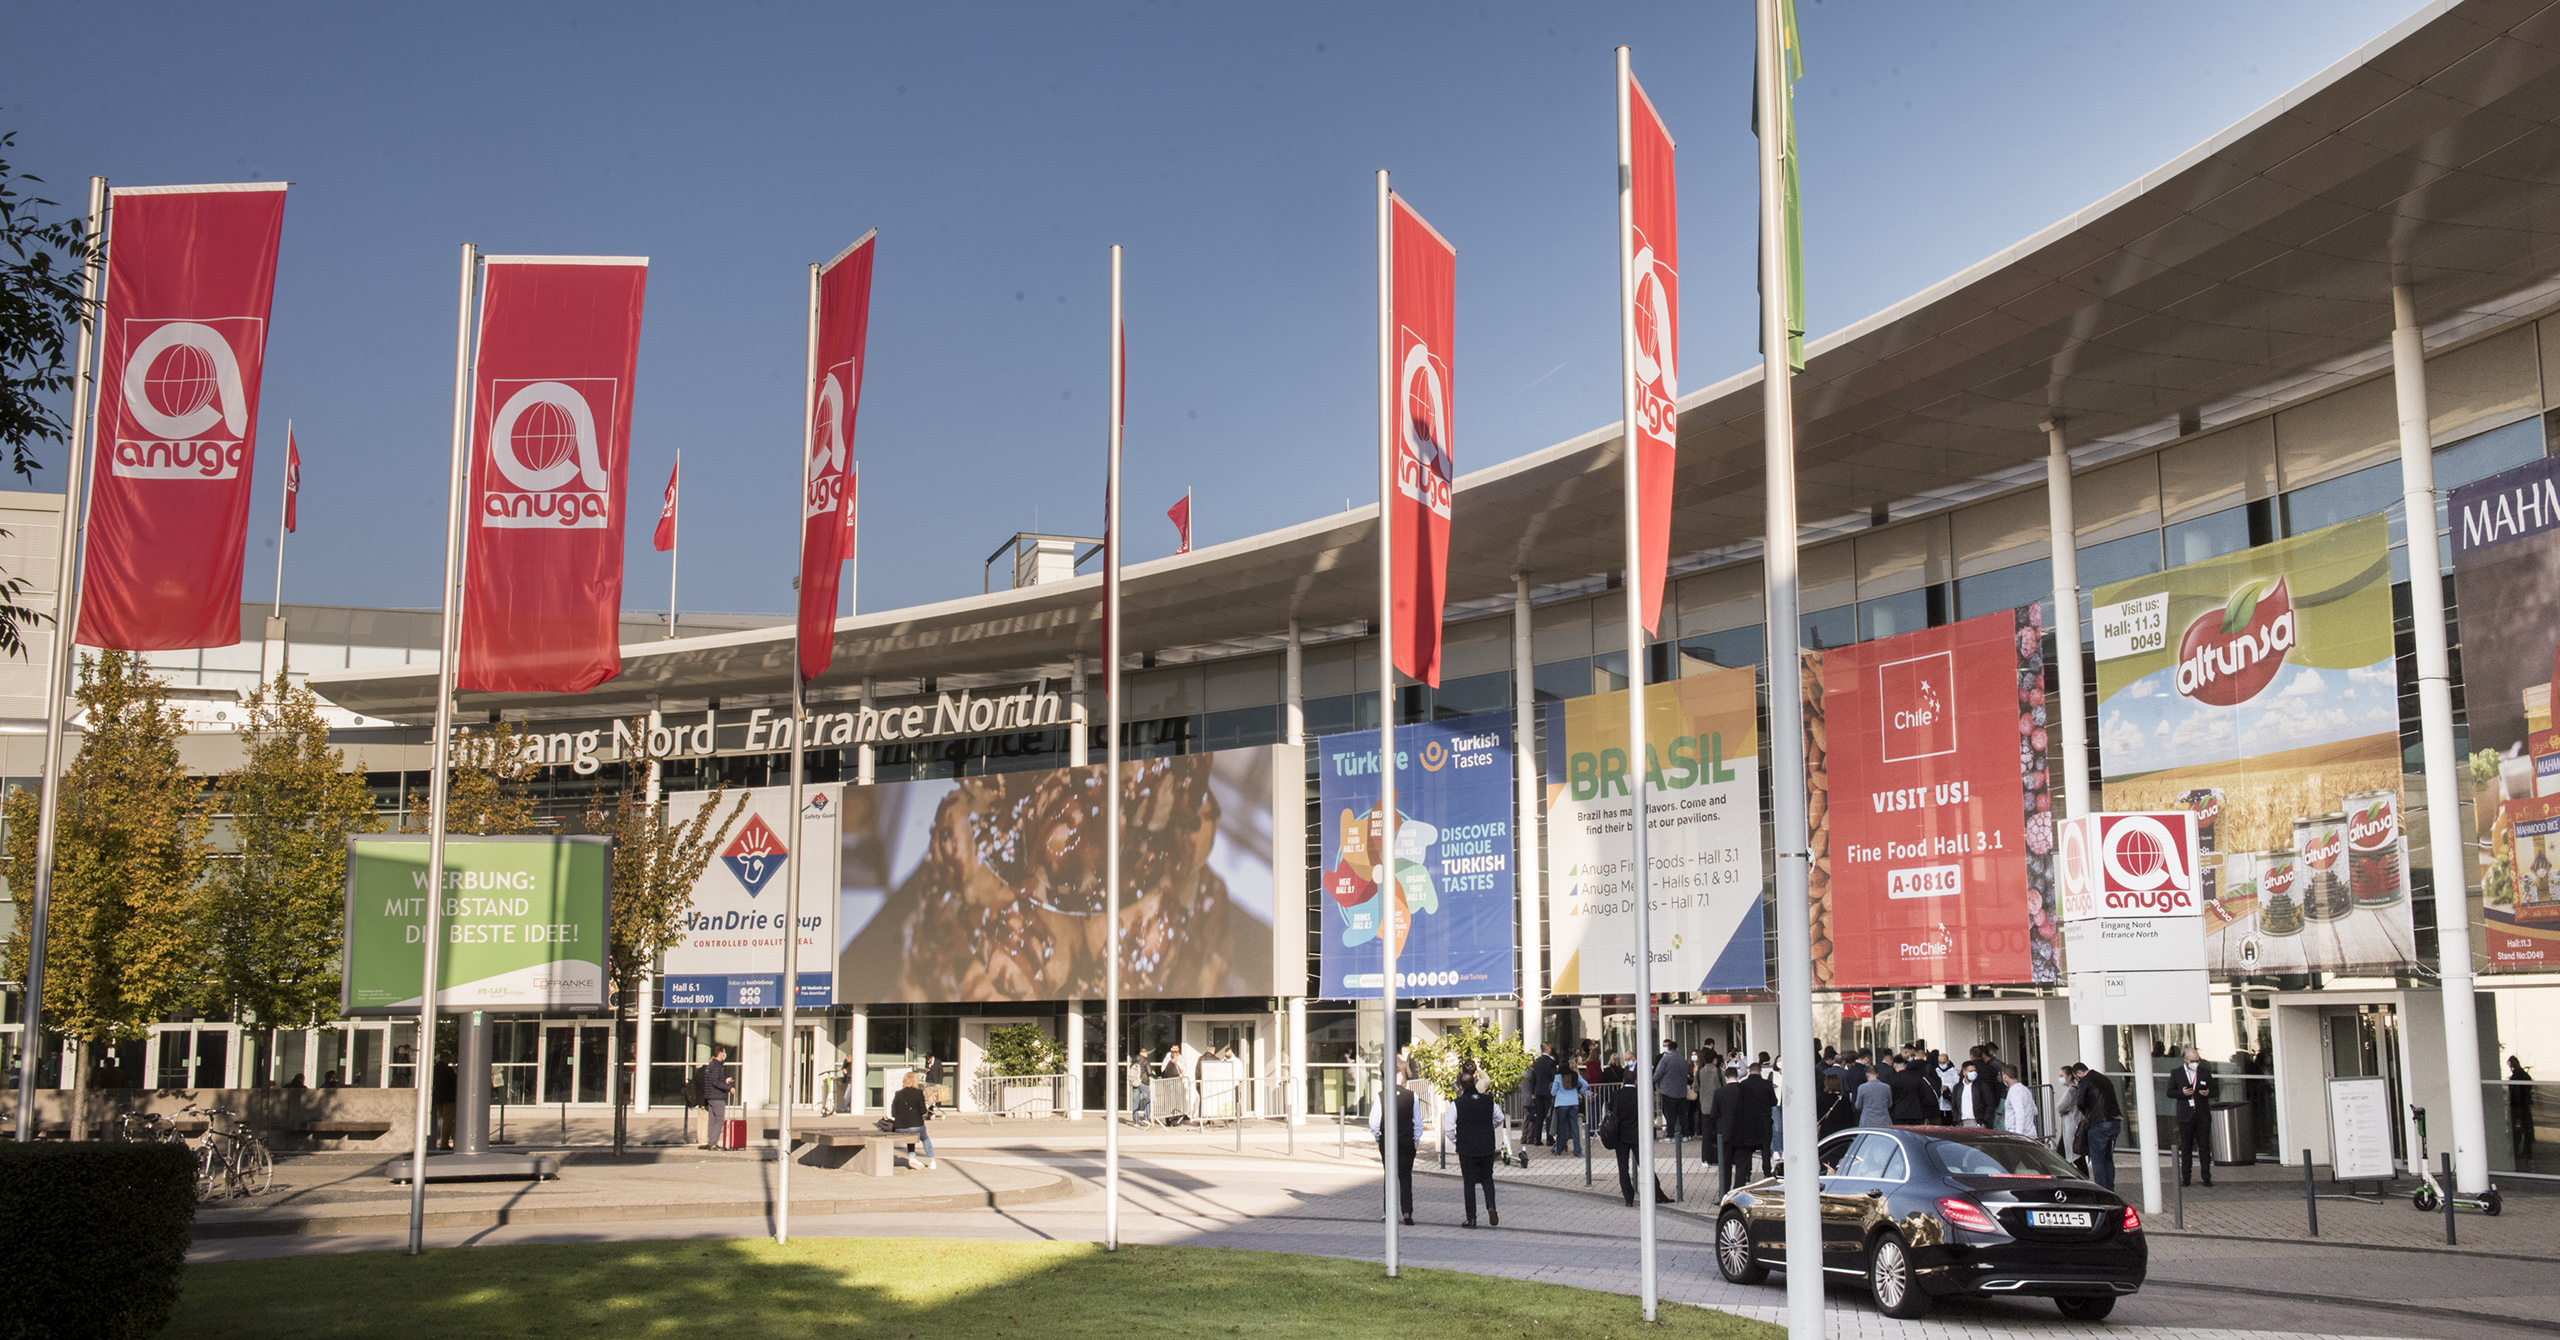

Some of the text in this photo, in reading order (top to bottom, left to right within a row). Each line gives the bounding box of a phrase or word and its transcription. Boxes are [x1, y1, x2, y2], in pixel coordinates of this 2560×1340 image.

[485, 493, 607, 526] anuga
[2121, 599, 2160, 617] Visit us:
[2104, 613, 2161, 639] Hall: 11.3
[2131, 632, 2162, 651] D049
[2177, 610, 2294, 696] altunsa
[612, 709, 715, 759] Nord
[745, 703, 928, 751] Entrance
[932, 676, 1064, 735] North
[1894, 706, 1932, 730] Chile
[1451, 732, 1500, 752] Turkish
[1333, 748, 1409, 777] Türkie
[1452, 753, 1493, 769] Tastes
[1571, 731, 1736, 802] BRASIL
[1872, 781, 1970, 813] VISIT US!
[1577, 810, 1601, 822] Brazil
[1603, 809, 1618, 819] has
[1680, 797, 1707, 810] Come
[1709, 794, 1727, 806] and
[1348, 827, 1359, 835] FINE
[1441, 821, 1506, 842] DISCOVER
[1586, 825, 1603, 835] find
[1604, 821, 1625, 833] their
[1648, 819, 1657, 829] at
[1659, 816, 1675, 828] our
[1677, 811, 1721, 828] pavilions.
[2349, 813, 2393, 842] altunsa
[2515, 819, 2560, 834] MAHMOOD RICE
[1343, 845, 1354, 854] HALL
[1347, 837, 1360, 845] FOOD
[1441, 839, 1492, 858] UNIQUE
[1847, 829, 2003, 863] Fine Food Hall 3.1
[1581, 863, 1617, 877] Anuga
[1648, 854, 1685, 870] Foods
[1698, 850, 1721, 866] Hall
[1724, 848, 1739, 863] 3.1
[2305, 840, 2341, 866] altunsa
[1441, 854, 1505, 876] TURKISH
[1339, 878, 1351, 886] MEAT
[1405, 874, 1427, 884] ORGANIC
[1409, 884, 1423, 893] FOOD
[1441, 873, 1494, 893] TASTES
[1581, 883, 1618, 897] Anuga
[1662, 873, 1690, 890] Halls
[1693, 872, 1709, 887] 6.1
[1711, 870, 1721, 885] &
[1724, 869, 1739, 884] 9.1
[1892, 870, 1955, 894] A-081G
[2264, 867, 2295, 891] altunsa
[1335, 886, 1346, 895] HALL
[384, 898, 425, 917] MIT
[1582, 902, 1618, 917] Anuga
[1671, 894, 1693, 909] Hall
[1697, 893, 1710, 907] 7.1
[2065, 894, 2093, 916] anuga
[2105, 891, 2192, 914] anuga
[687, 910, 768, 931] VanDrie
[1353, 913, 1371, 922] DRINKS
[2100, 921, 2152, 930] Eingang Nord
[450, 924, 516, 943] BESTE
[524, 923, 579, 943] IDEE!
[693, 939, 748, 948] CONTROLLED
[798, 937, 814, 946] EAL
[2101, 930, 2159, 939] Entrance North
[1901, 942, 1947, 956] ProChile
[2497, 951, 2516, 960] Stand
[547, 979, 594, 987] FRANKE
[672, 982, 700, 992] Hall 6.1
[672, 994, 714, 1004] Stand B010
[2052, 1213, 2086, 1225] 111-5
